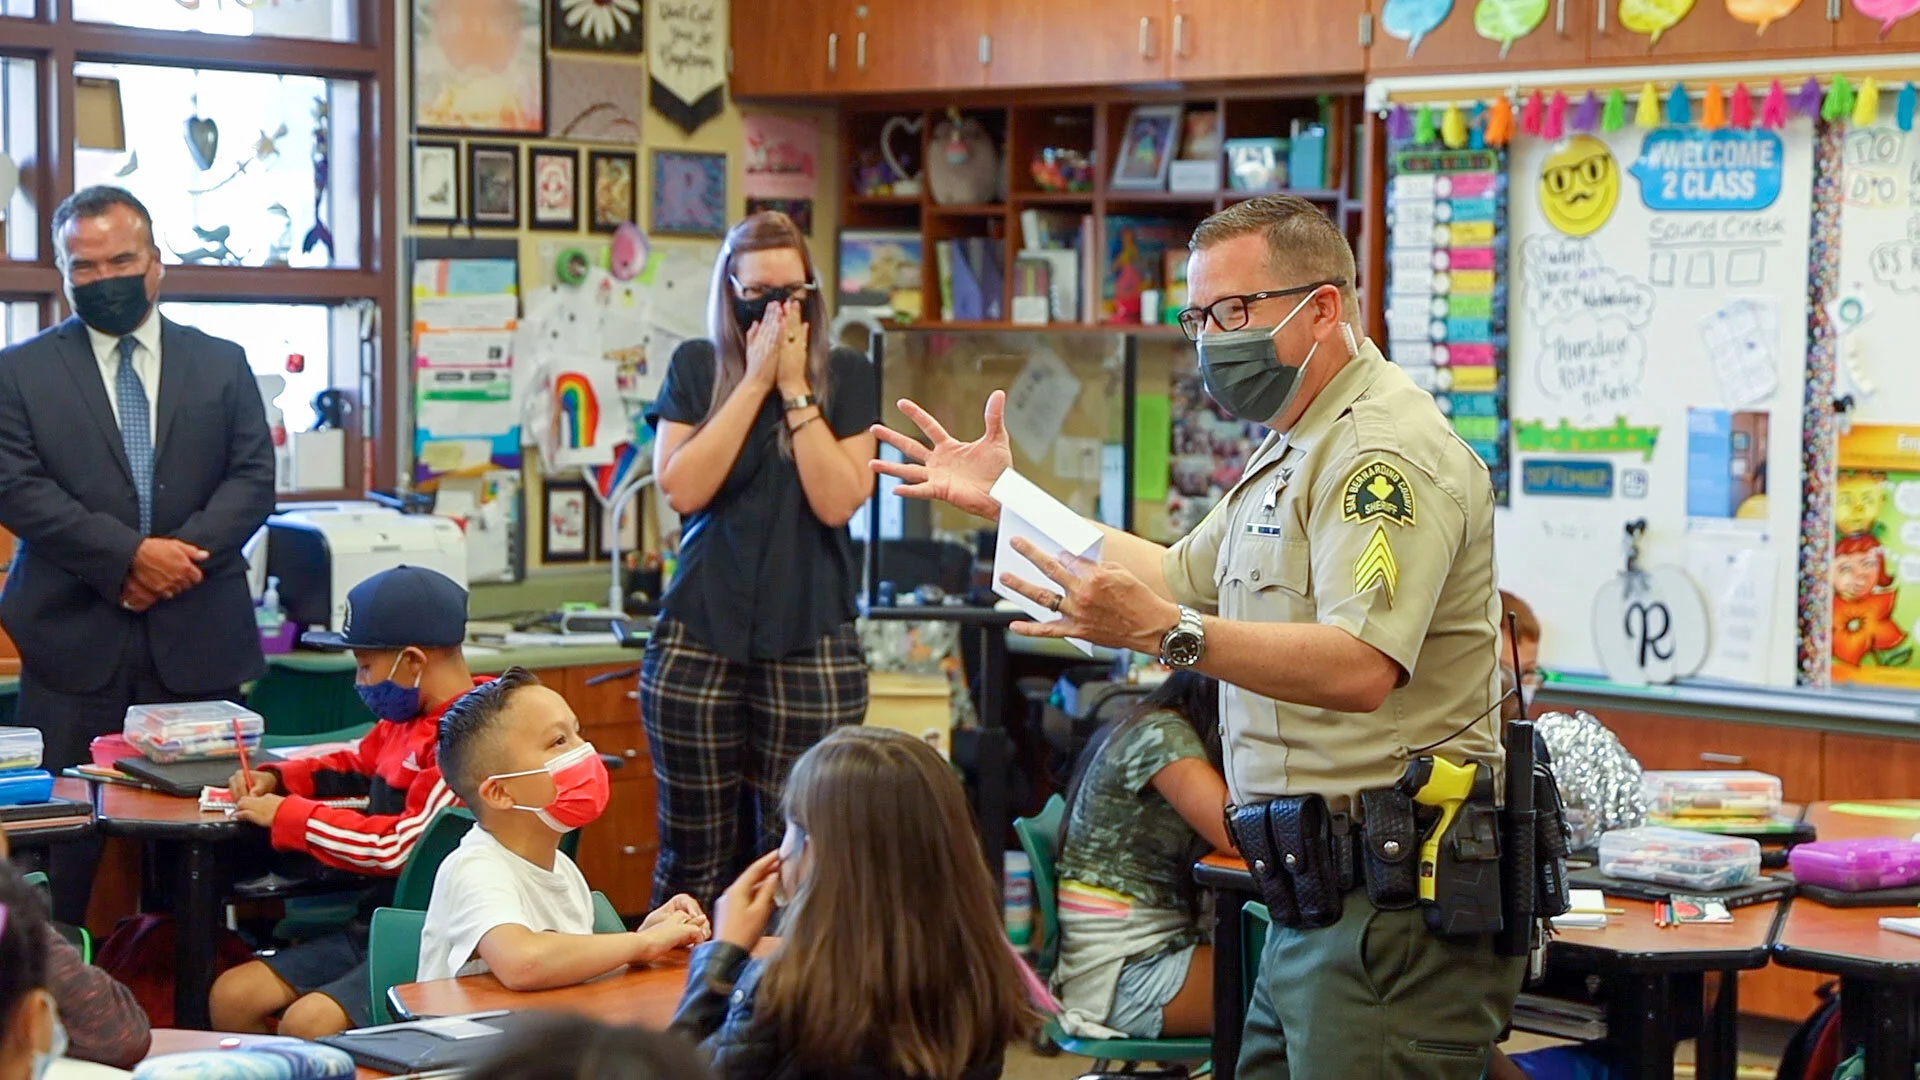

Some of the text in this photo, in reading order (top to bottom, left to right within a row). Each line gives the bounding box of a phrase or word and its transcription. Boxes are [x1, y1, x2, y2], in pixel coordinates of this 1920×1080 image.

[1662, 171, 1756, 199] 2 CLASS
[1345, 464, 1413, 516] SAN BERNARDINO COUNTY
[1364, 500, 1398, 515] SHERIFF
[1625, 602, 1675, 667] R
